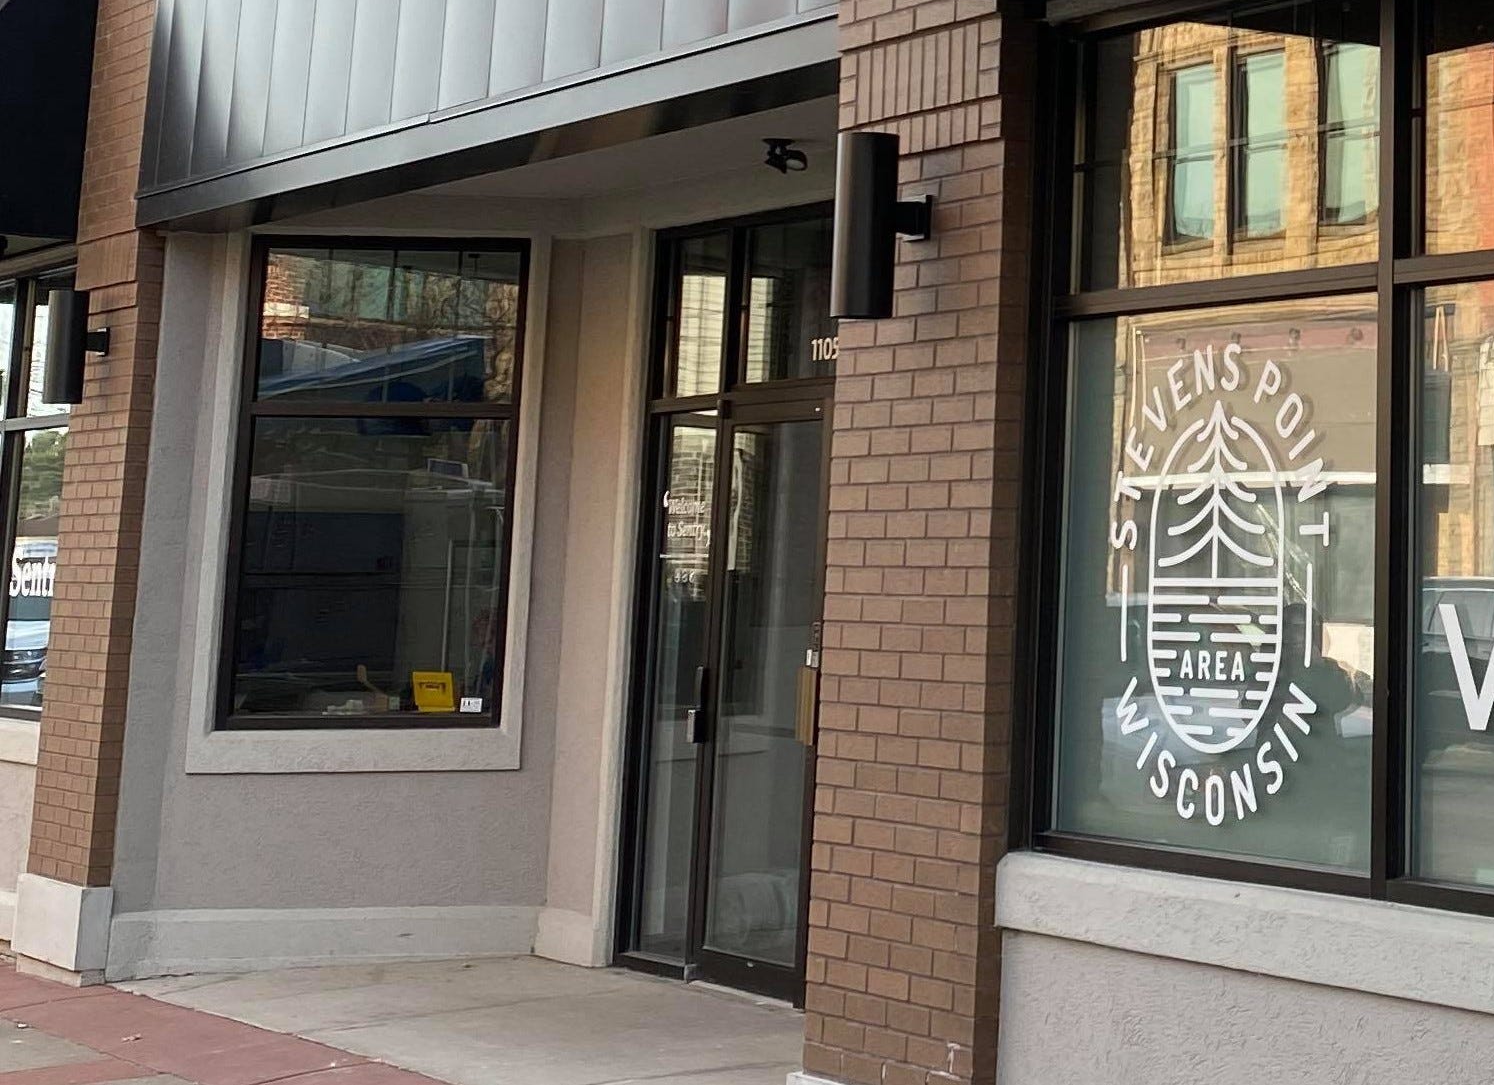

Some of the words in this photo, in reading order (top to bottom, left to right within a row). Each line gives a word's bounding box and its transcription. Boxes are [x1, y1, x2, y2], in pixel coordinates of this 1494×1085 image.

[1112, 343, 1241, 551] STEVENS
[1253, 359, 1330, 547] POINT
[1179, 650, 1246, 682] AREA
[1116, 677, 1317, 827] WISCONSIN
